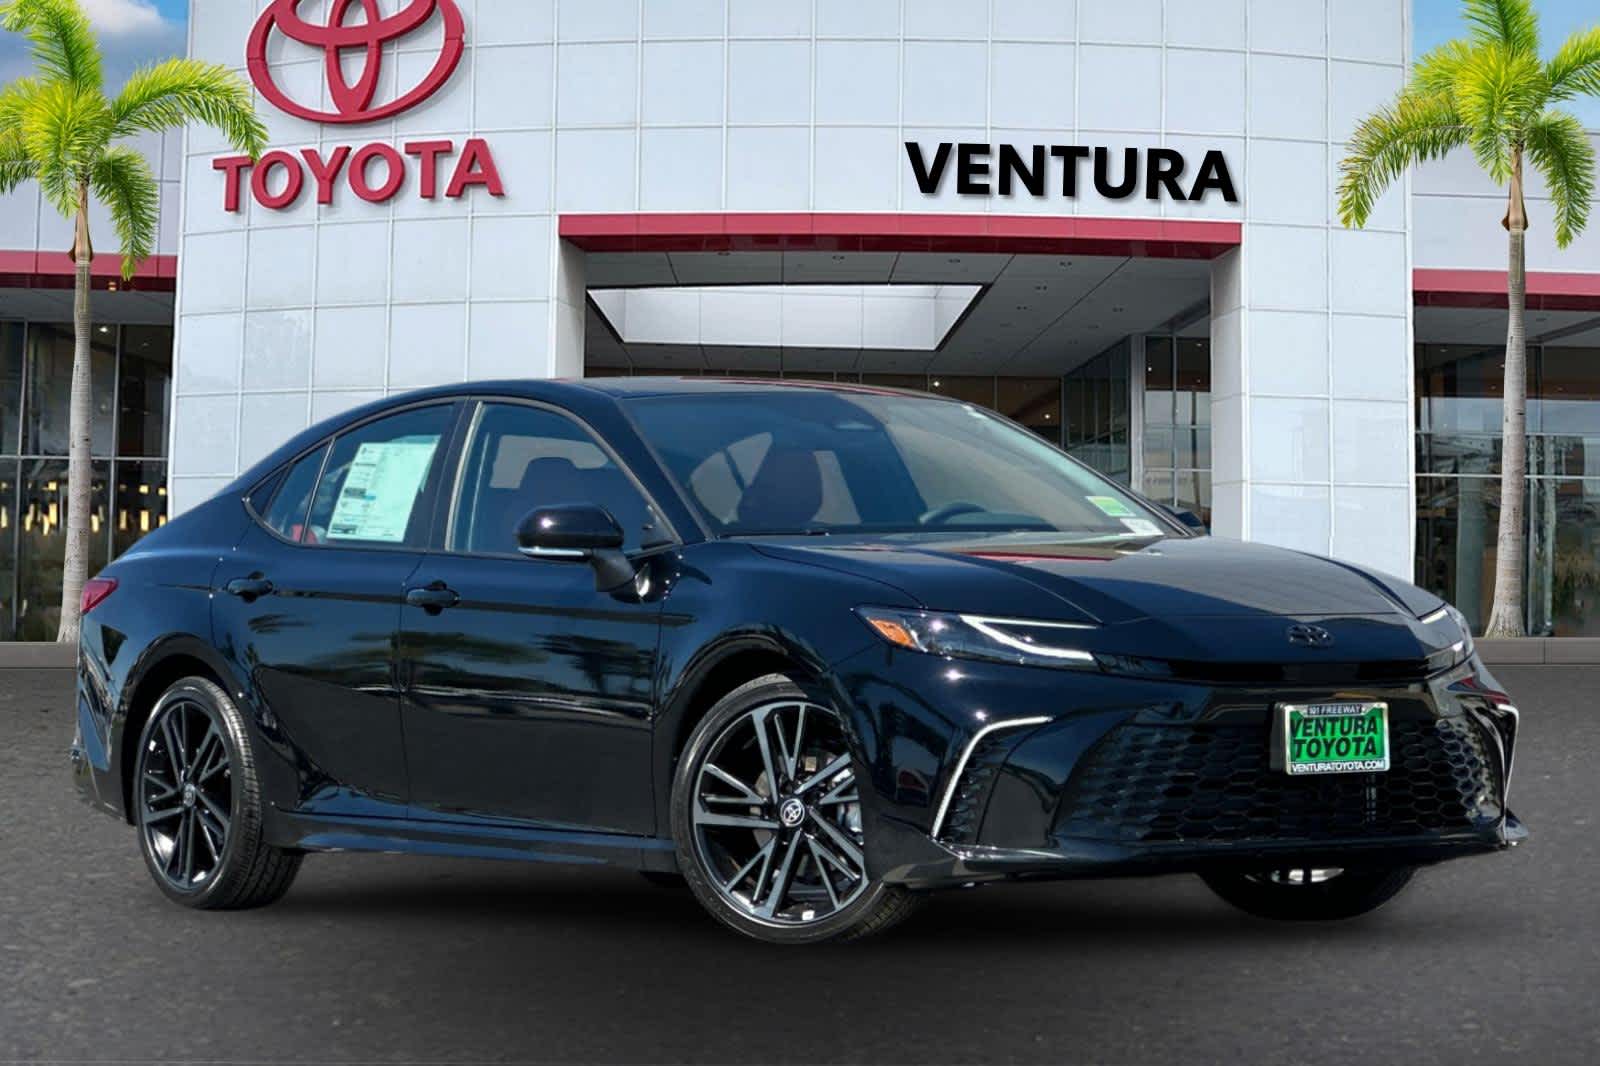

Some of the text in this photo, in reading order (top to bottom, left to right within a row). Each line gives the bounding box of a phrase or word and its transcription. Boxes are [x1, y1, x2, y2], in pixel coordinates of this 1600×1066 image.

[212, 138, 505, 212] TOYOTA
[904, 141, 1239, 203] VENTURA
[1321, 705, 1360, 713] FREEWAY
[1290, 715, 1378, 737] VENTURA
[1294, 737, 1376, 757] TOYOTA
[1292, 761, 1384, 772] VENTURATOYOTA.COM
